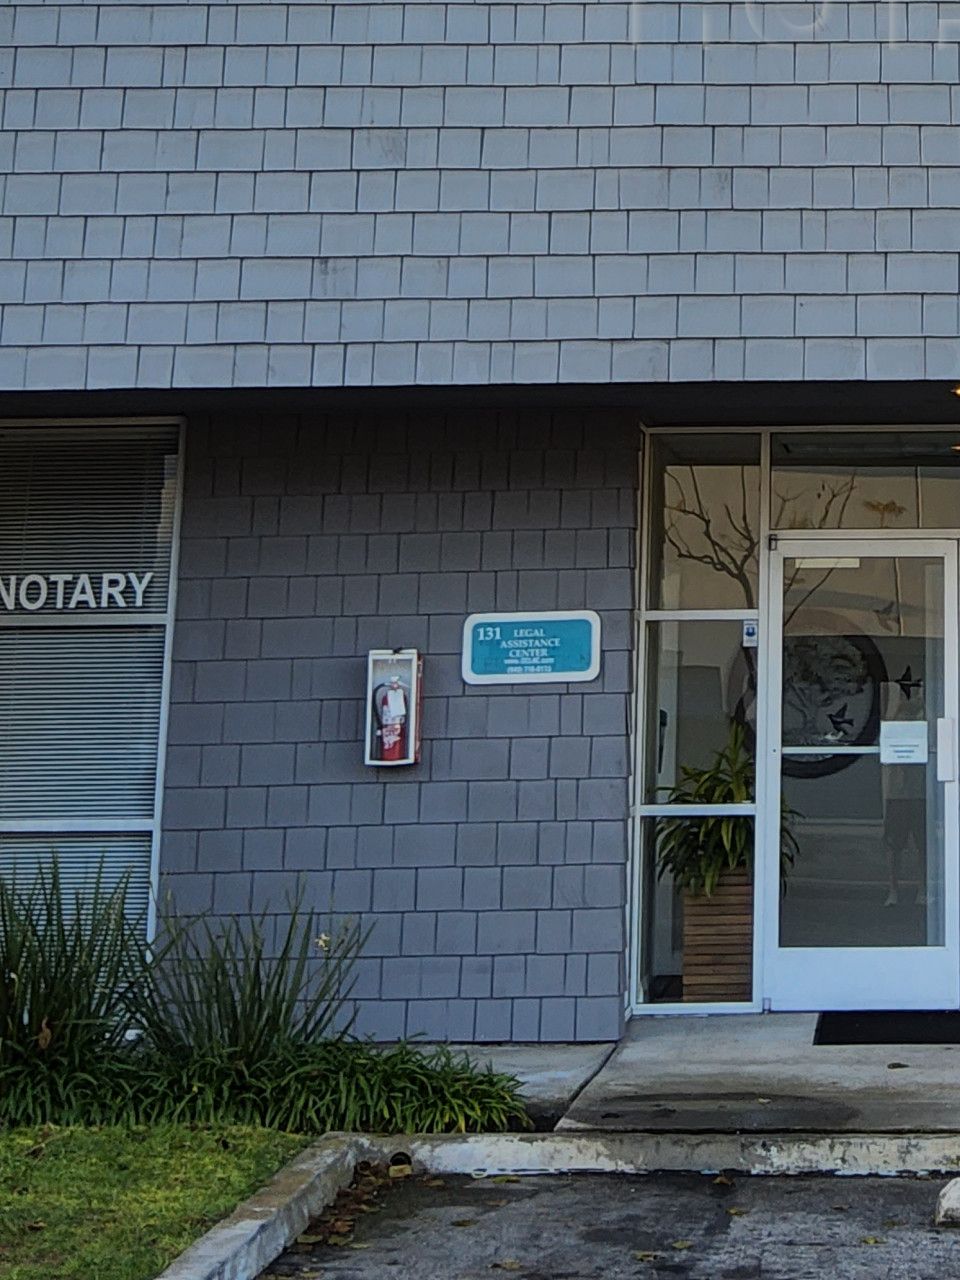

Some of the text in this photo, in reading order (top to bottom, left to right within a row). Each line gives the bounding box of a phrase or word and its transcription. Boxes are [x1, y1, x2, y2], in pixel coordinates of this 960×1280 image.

[0, 572, 154, 610] NOTARY
[477, 627, 502, 641] 131
[513, 629, 546, 637] LEGAL
[500, 638, 561, 649] ASSISTANCE
[508, 648, 548, 657] CENTER
